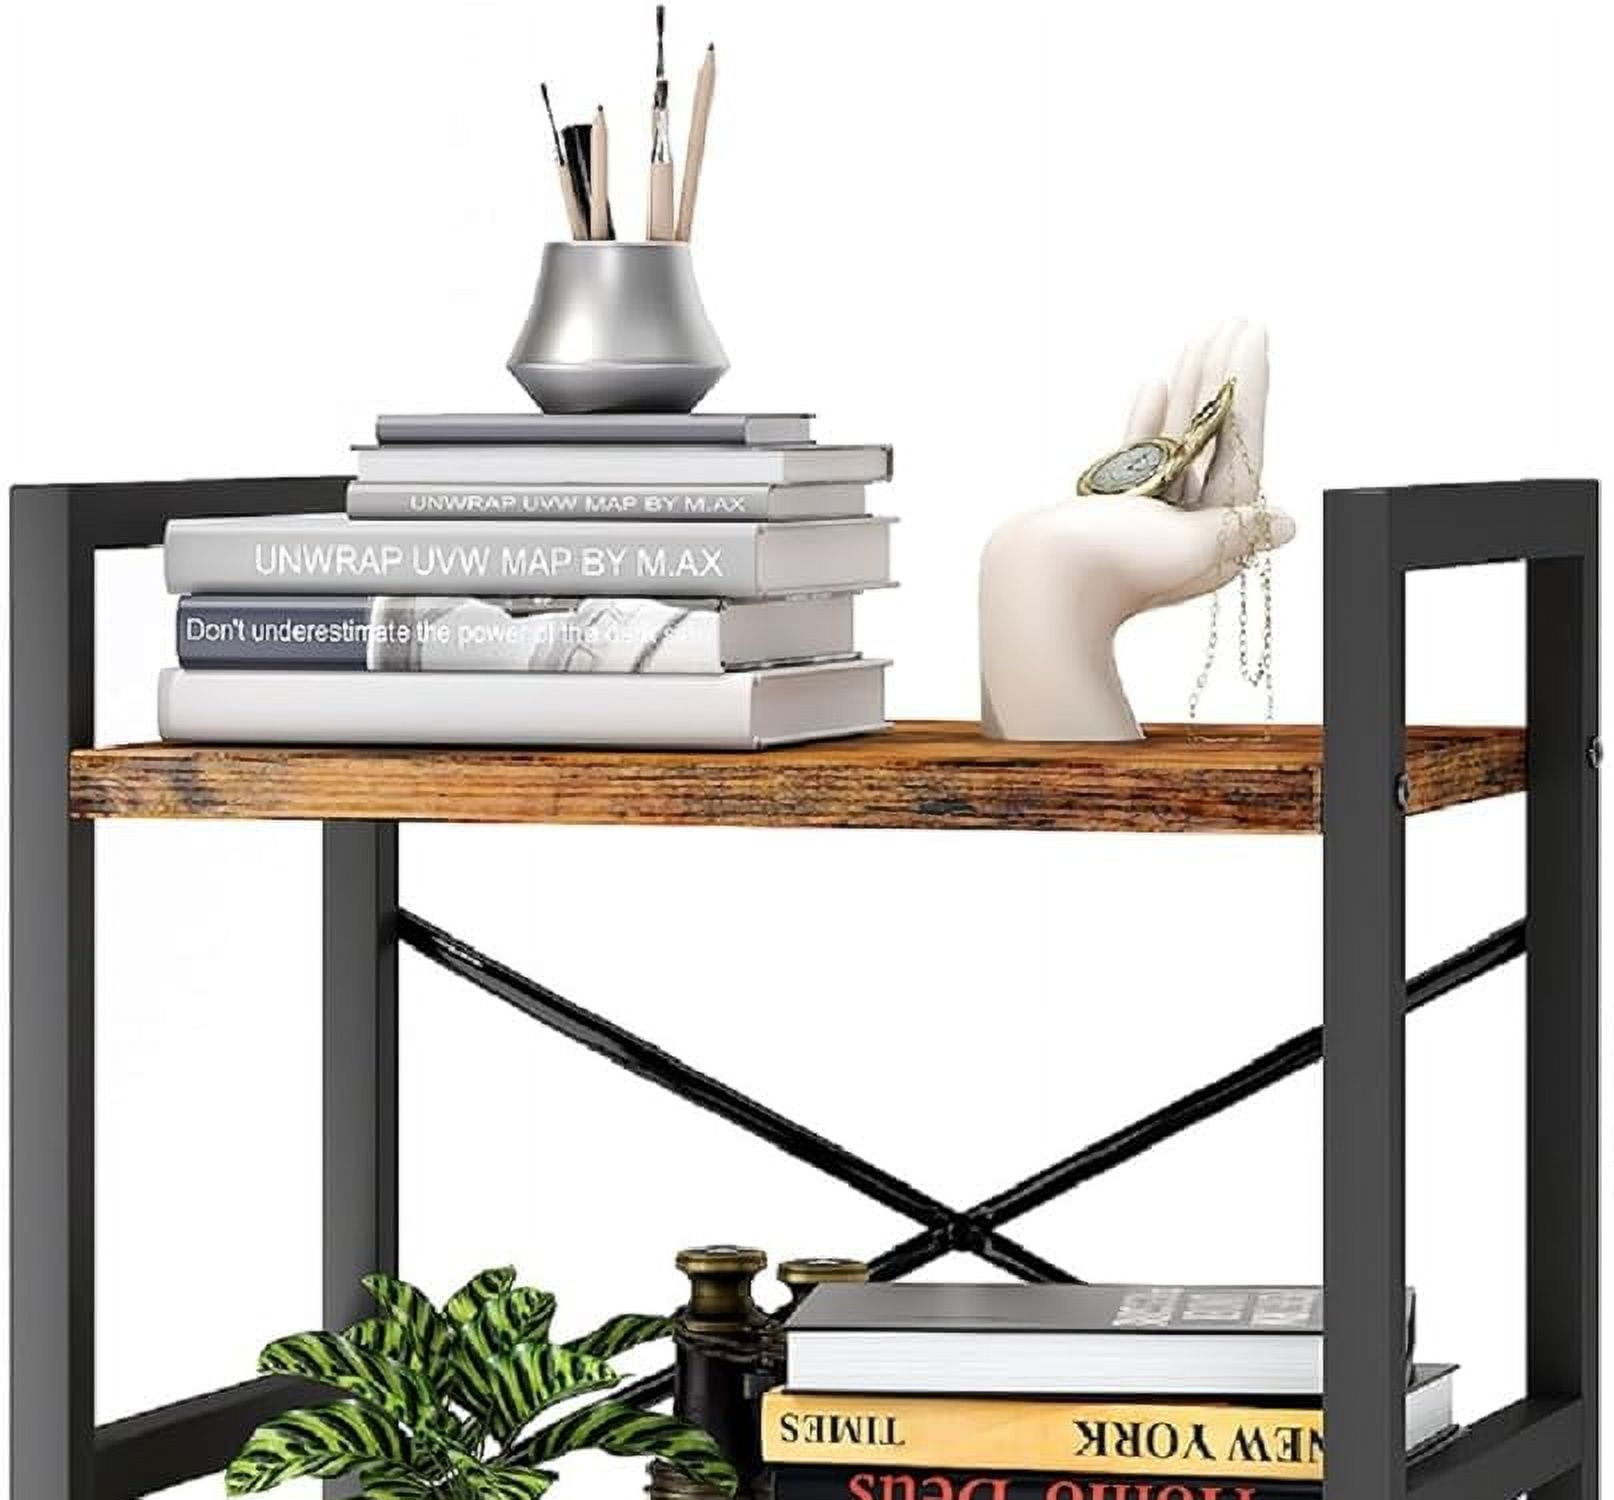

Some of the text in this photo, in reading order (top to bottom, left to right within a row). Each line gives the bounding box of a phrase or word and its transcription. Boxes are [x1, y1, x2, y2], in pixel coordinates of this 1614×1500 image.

[409, 494, 747, 513] UNWRAP UVW MAP BY M.AX
[255, 543, 724, 578] UNWRAP UVW MAP BY M.AX
[186, 617, 246, 642] Don't
[252, 618, 411, 643] underestimate
[416, 618, 450, 643] the
[780, 1412, 906, 1446] TIMES
[1072, 1420, 1217, 1460] YORK
